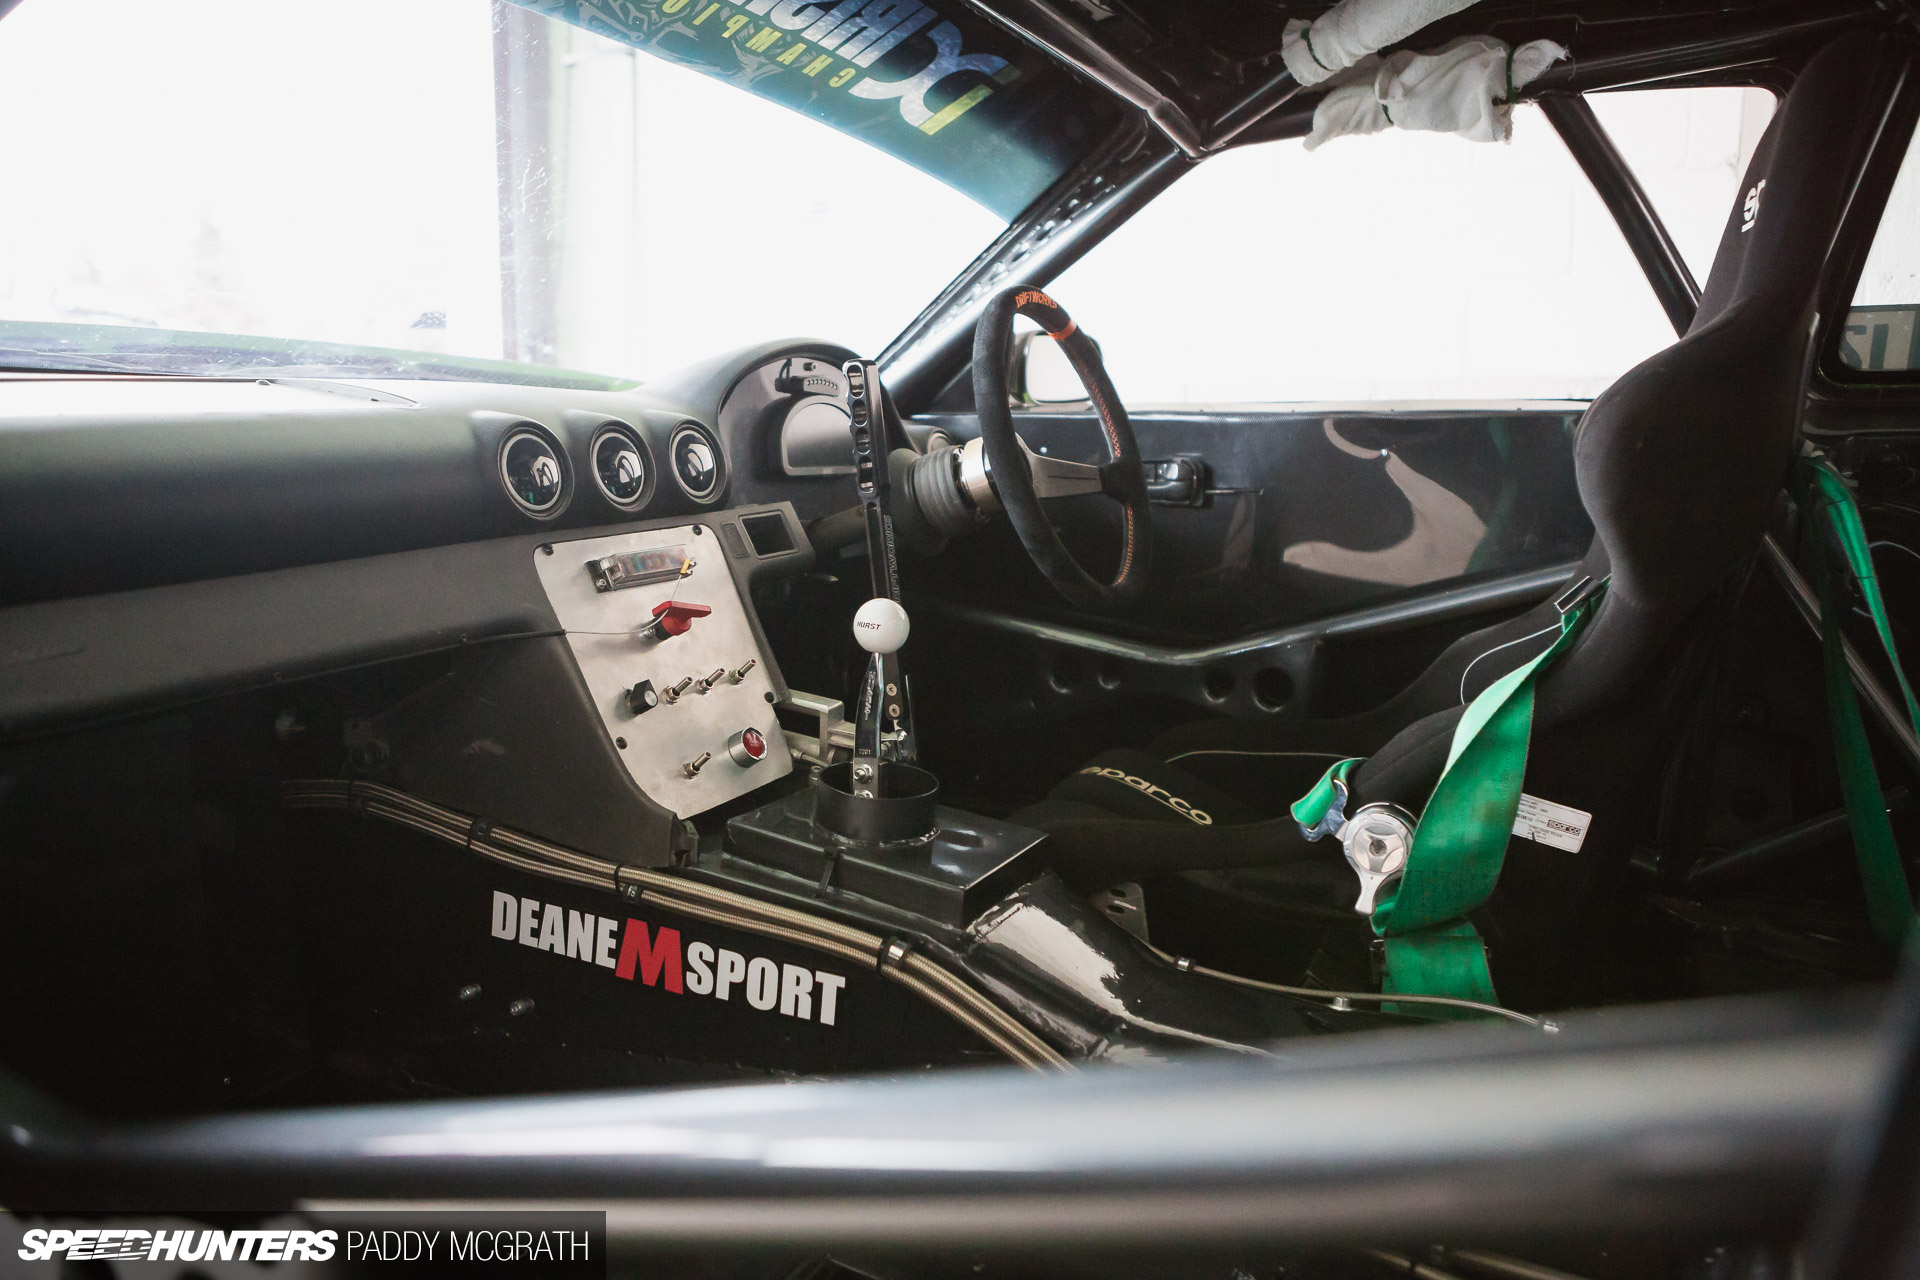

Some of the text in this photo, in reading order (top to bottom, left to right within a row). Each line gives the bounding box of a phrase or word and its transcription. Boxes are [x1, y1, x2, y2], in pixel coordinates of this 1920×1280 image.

[1015, 290, 1058, 309] DRIFTWORKS
[883, 514, 901, 605] RIFTWORKS
[856, 620, 882, 630] HURST
[1079, 766, 1213, 825] sparco
